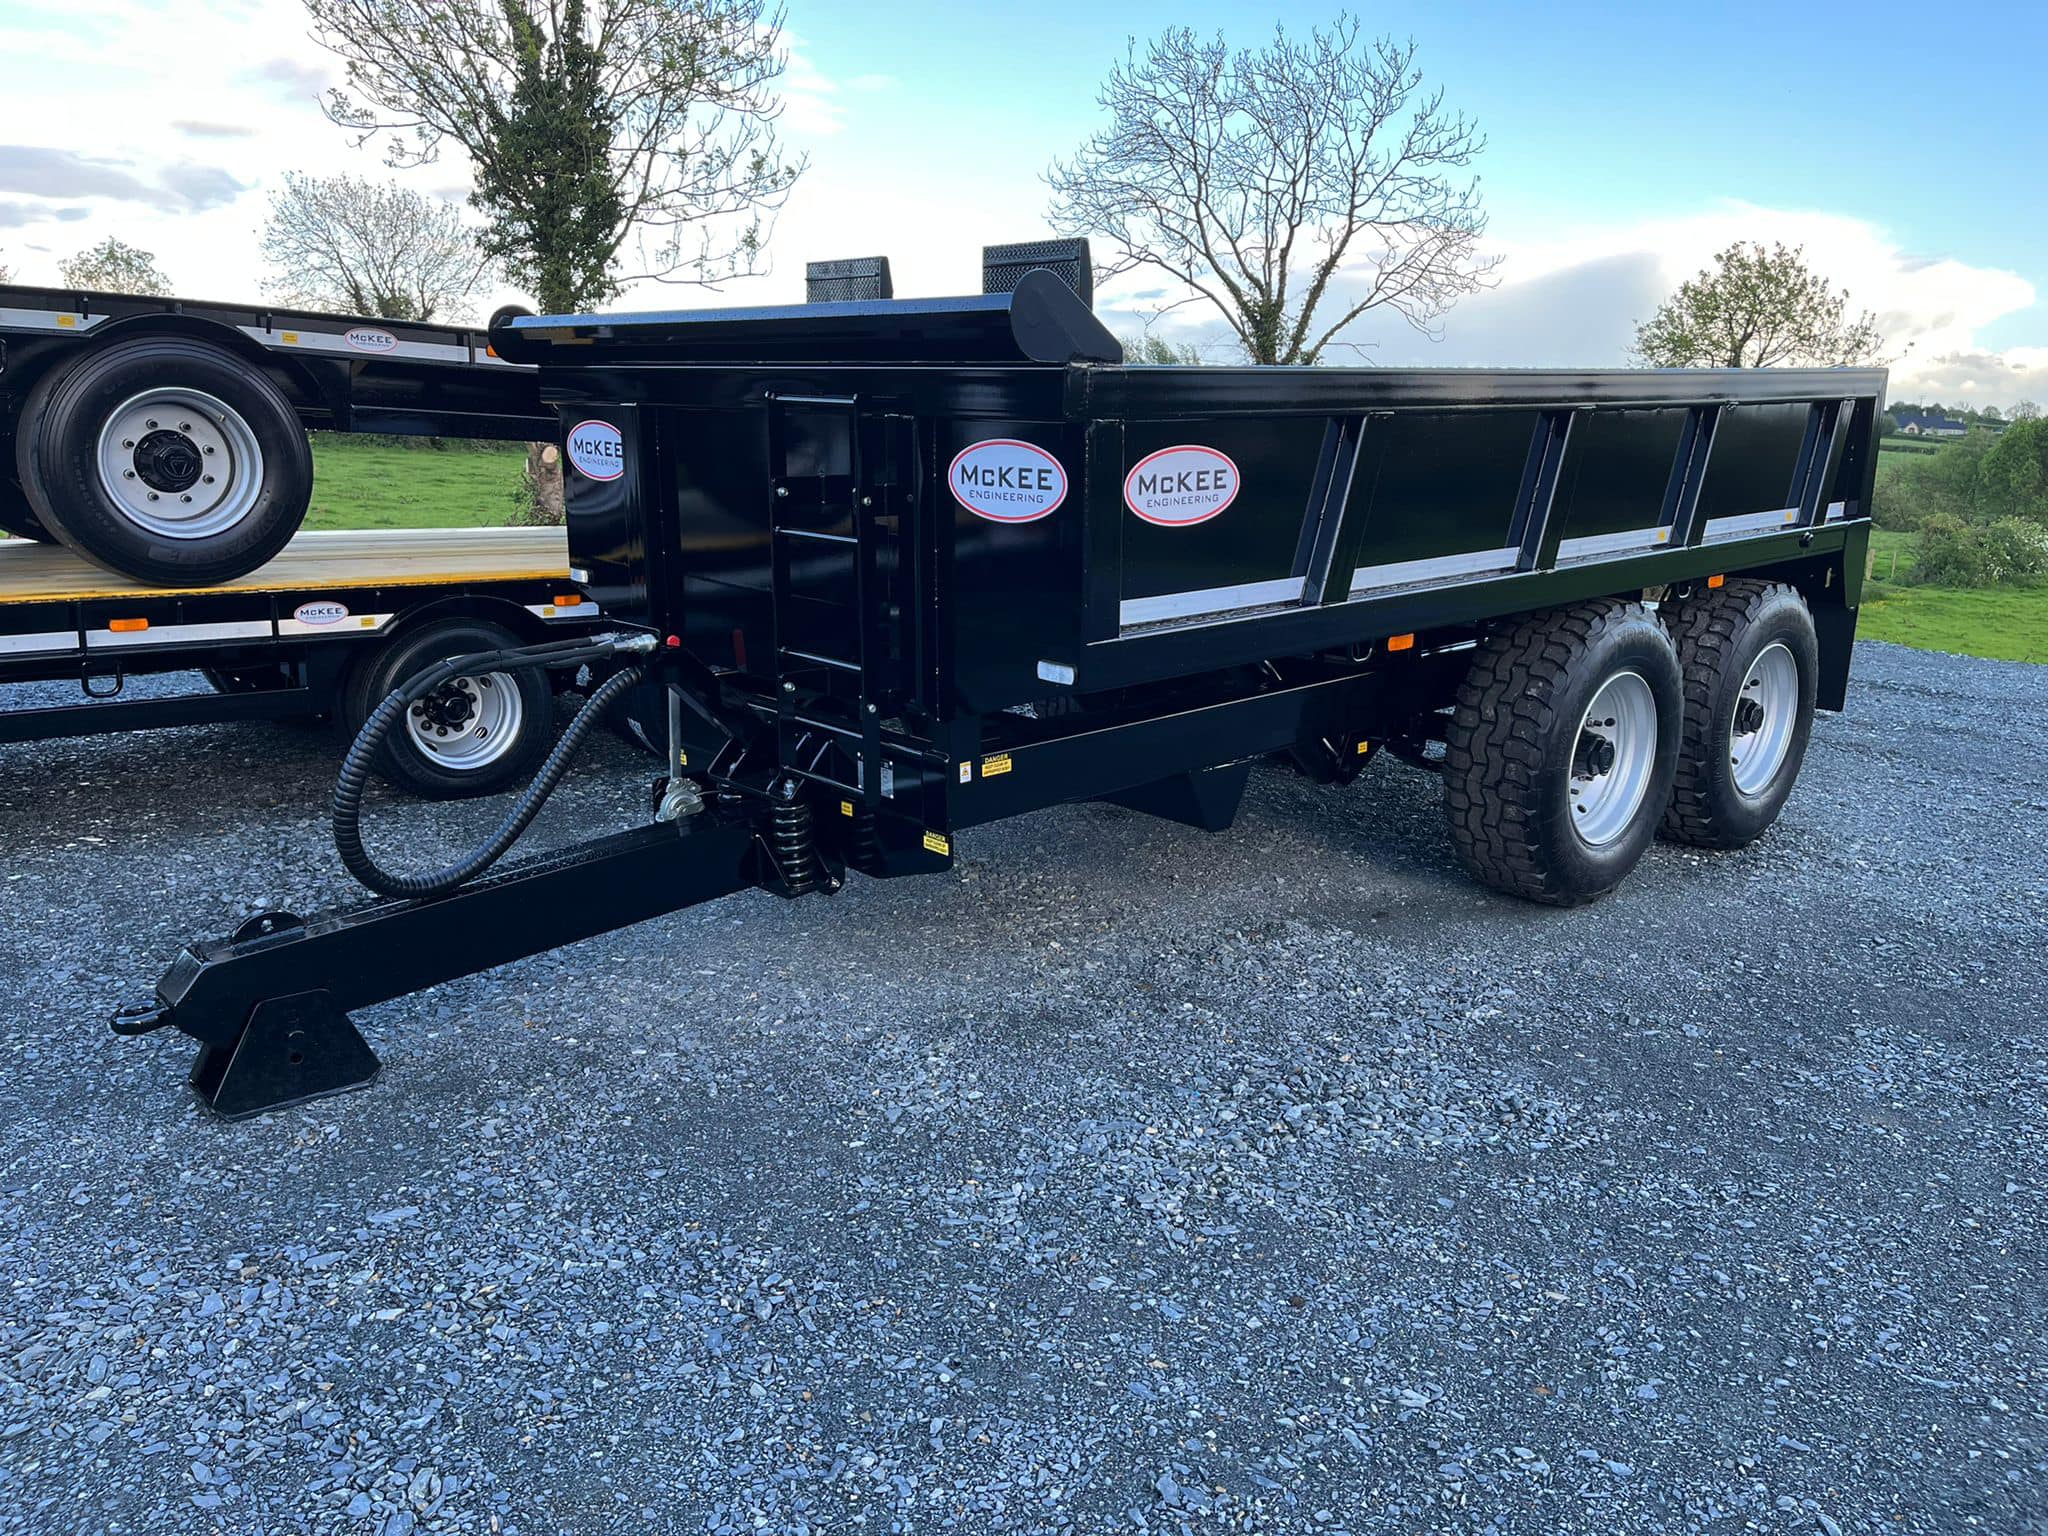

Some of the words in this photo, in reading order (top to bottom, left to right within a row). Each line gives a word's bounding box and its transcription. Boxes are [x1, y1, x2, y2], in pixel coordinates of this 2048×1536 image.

[350, 333, 392, 344] McKEE
[573, 438, 624, 458] McKEE
[961, 463, 1053, 491] McKEE
[1138, 469, 1228, 496] McKEE
[969, 489, 1044, 504] ENGINEERING
[1147, 494, 1219, 508] ENGINEERING
[300, 607, 343, 616] McKEE
